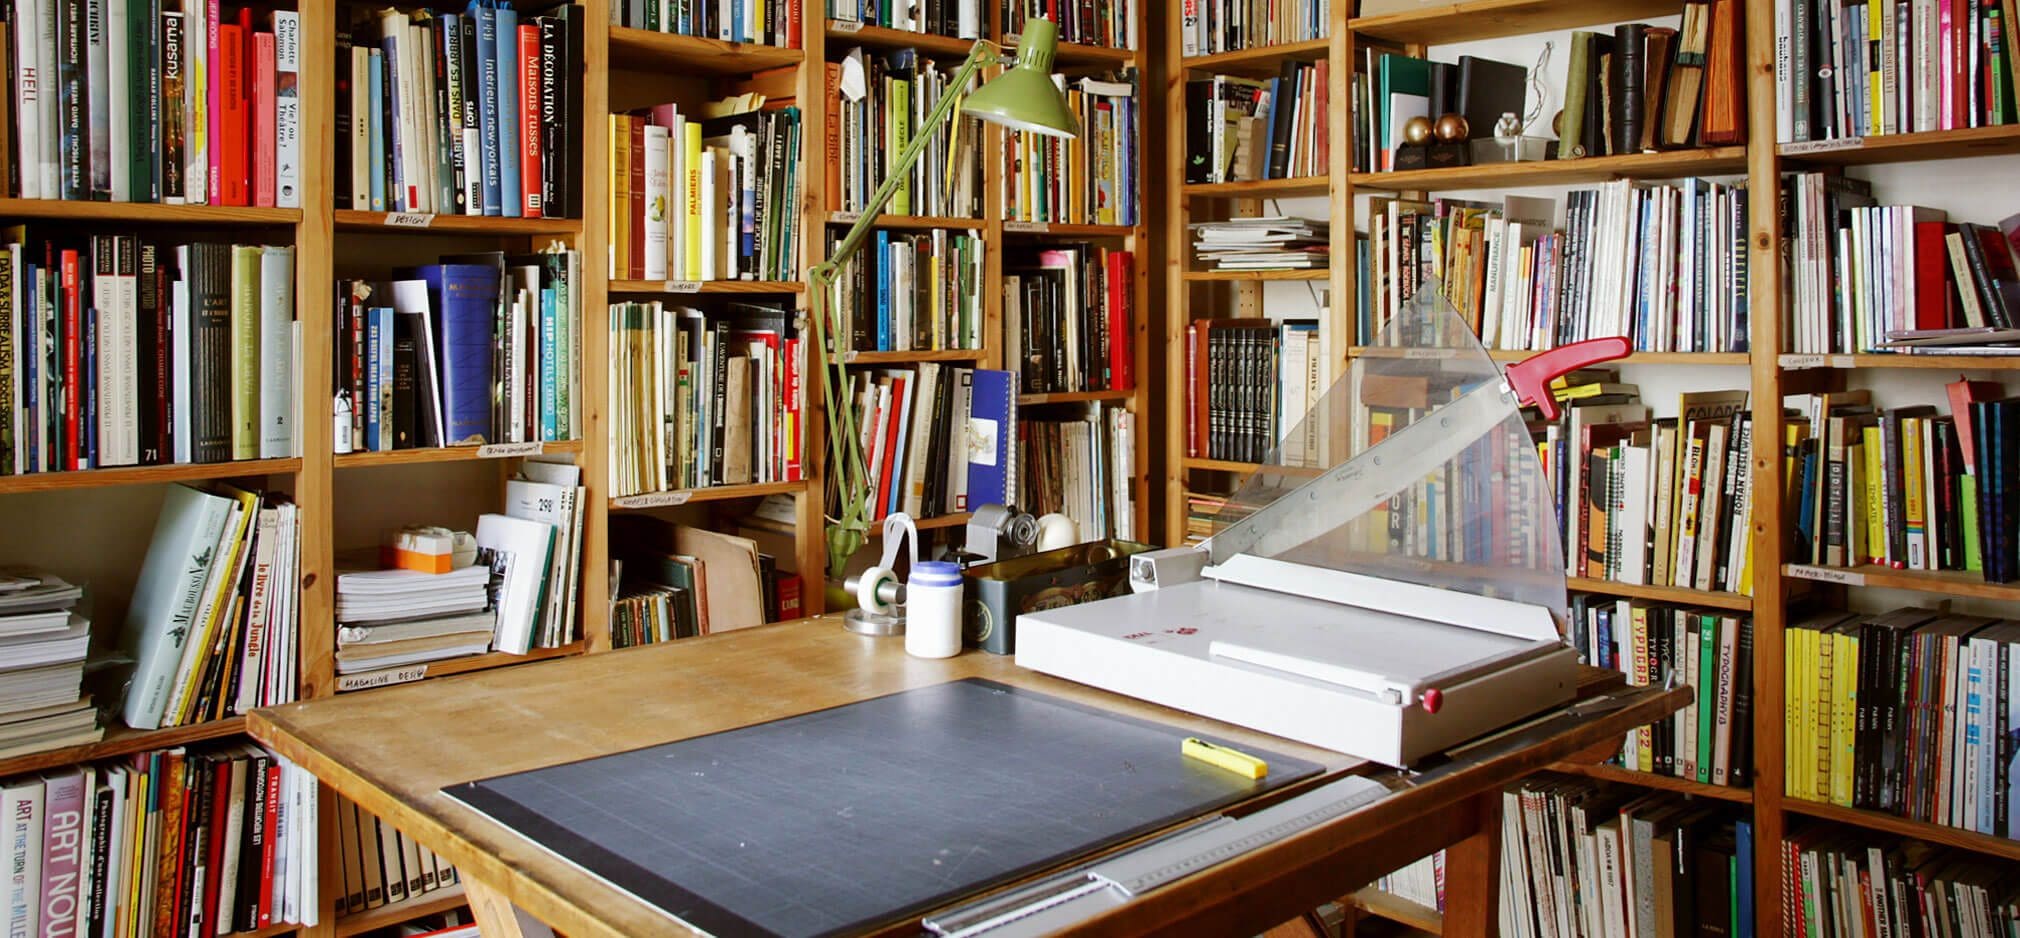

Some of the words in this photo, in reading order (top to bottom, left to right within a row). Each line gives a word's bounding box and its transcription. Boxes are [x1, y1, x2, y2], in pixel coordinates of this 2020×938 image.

[208, 1, 217, 20] JEFF
[209, 22, 218, 49] KOONS
[279, 19, 287, 60] Salomon
[288, 19, 296, 65] Charlotte
[544, 24, 554, 39] LA
[165, 18, 178, 79] kusama
[448, 25, 459, 68] ARBRES
[23, 67, 37, 104] HELL
[450, 70, 459, 88] LES
[485, 58, 495, 115] Intérieurs
[528, 55, 539, 110] Maisons
[544, 45, 556, 123] DÉCORATION
[451, 91, 461, 119] DANS
[466, 101, 475, 126] LOFTS
[288, 127, 296, 140] ou
[829, 112, 839, 128] La
[71, 135, 79, 163] FISCHLI
[529, 115, 539, 156] russes
[829, 134, 840, 165] Bible
[485, 118, 497, 186] new-yorkais
[755, 210, 762, 221] DE
[142, 246, 155, 273] PHOTO
[1490, 231, 1500, 292] MANUFRANCE
[0, 258, 10, 291] DADA
[0, 301, 9, 370] SURREALISM
[505, 312, 513, 336] NEW
[546, 317, 554, 341] HIP
[505, 342, 514, 398] ENGLAND
[546, 344, 554, 382] HOTELS
[145, 449, 157, 461] 71
[537, 498, 553, 512] 298
[1734, 480, 1744, 516] ROMAN
[258, 563, 270, 573] le
[172, 567, 205, 625] MAUBOUSSIN
[255, 574, 269, 597] livre
[252, 610, 261, 619] la
[254, 600, 262, 609] de
[248, 622, 263, 657] Jungle
[1635, 616, 1647, 684] TYPOGRA
[1649, 637, 1658, 681] TYPOGR
[1719, 644, 1731, 714] TYPOGRAPHY
[1640, 728, 1650, 748] 22
[269, 775, 279, 814] TRANSIT
[16, 800, 33, 821] ART
[16, 823, 28, 832] AT
[50, 810, 81, 866] ART
[98, 800, 109, 853] Photographie
[15, 834, 27, 849] THE
[13, 851, 26, 874] TURN
[96, 855, 105, 877] d'une
[13, 875, 26, 886] OF
[12, 887, 25, 904] THE
[45, 871, 78, 938] NOU
[93, 880, 104, 920] collection
